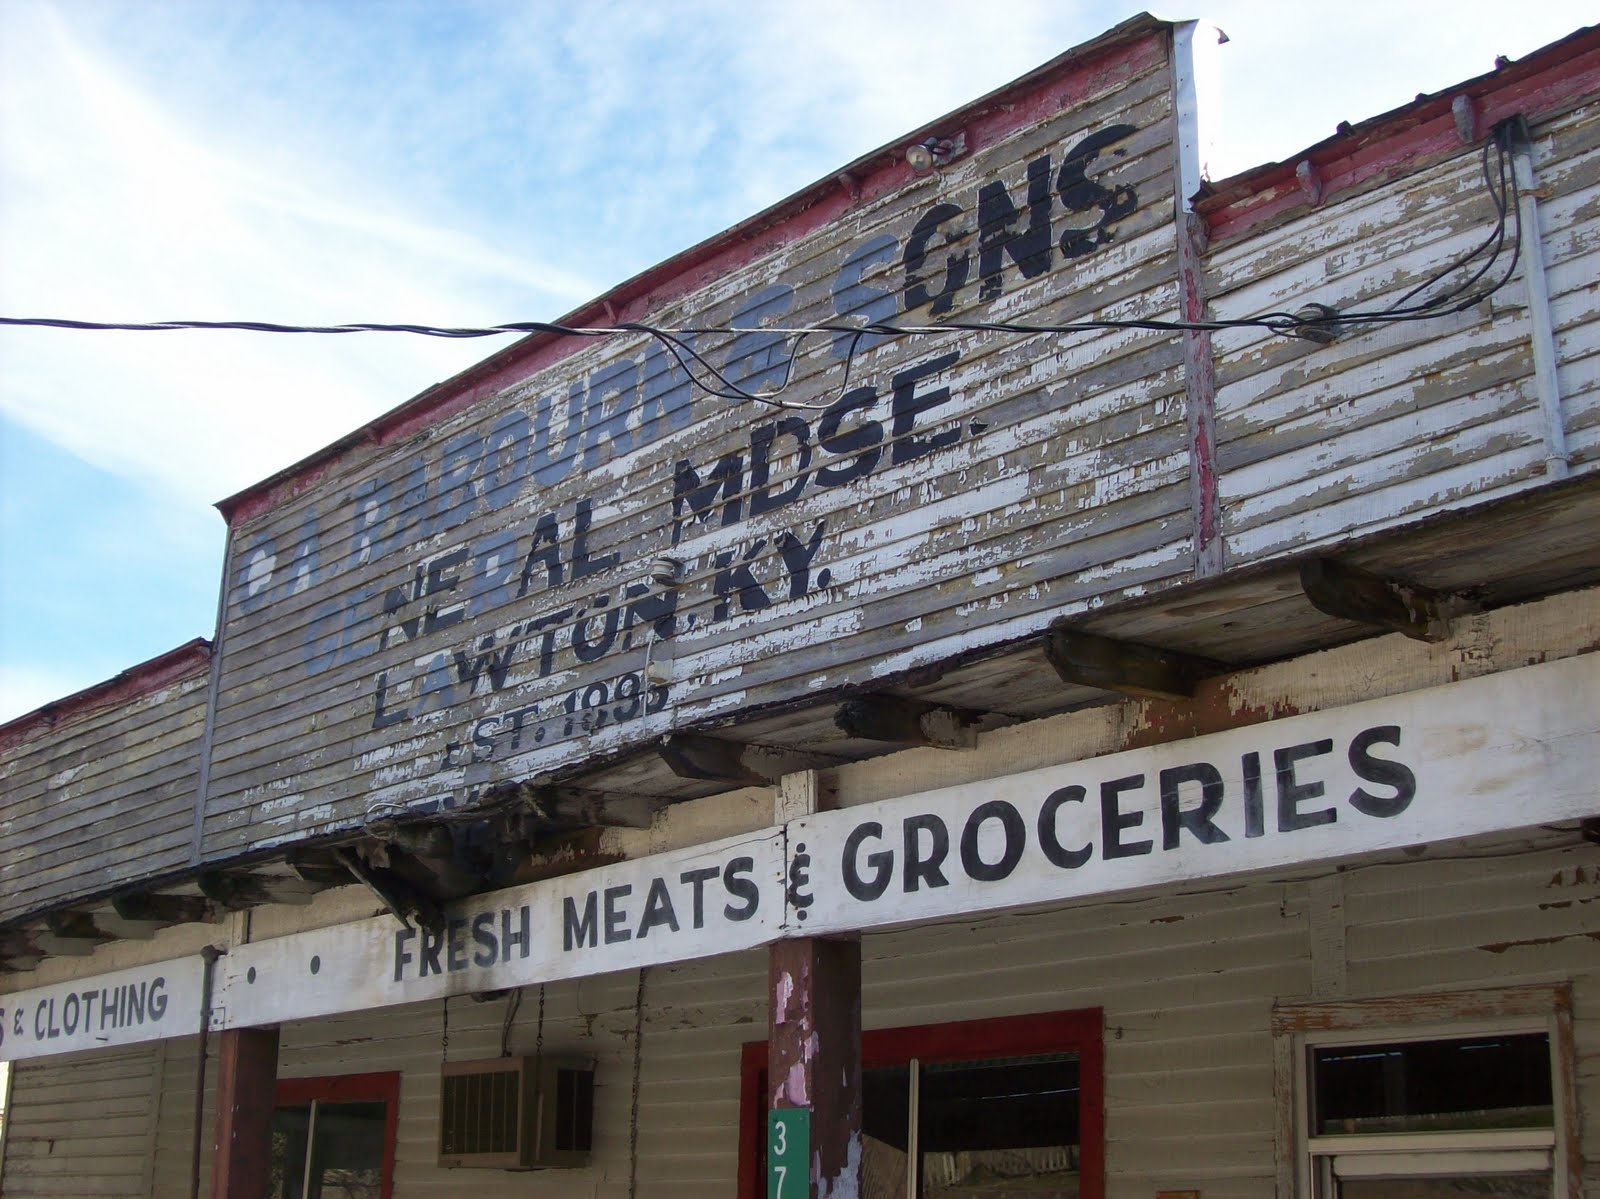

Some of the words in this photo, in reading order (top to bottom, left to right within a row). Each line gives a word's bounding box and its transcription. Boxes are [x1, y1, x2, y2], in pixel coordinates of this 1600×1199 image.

[831, 123, 1139, 360] SONS
[303, 497, 620, 676] GENERAL
[671, 351, 988, 544] MDSE.
[713, 519, 832, 622] KY.
[394, 905, 530, 982] FRESH
[563, 857, 760, 951] MEATS
[788, 843, 814, 920] &
[842, 725, 1416, 901] GROCERIES
[13, 1008, 24, 1036] &
[35, 977, 168, 1041] CLOTHING
